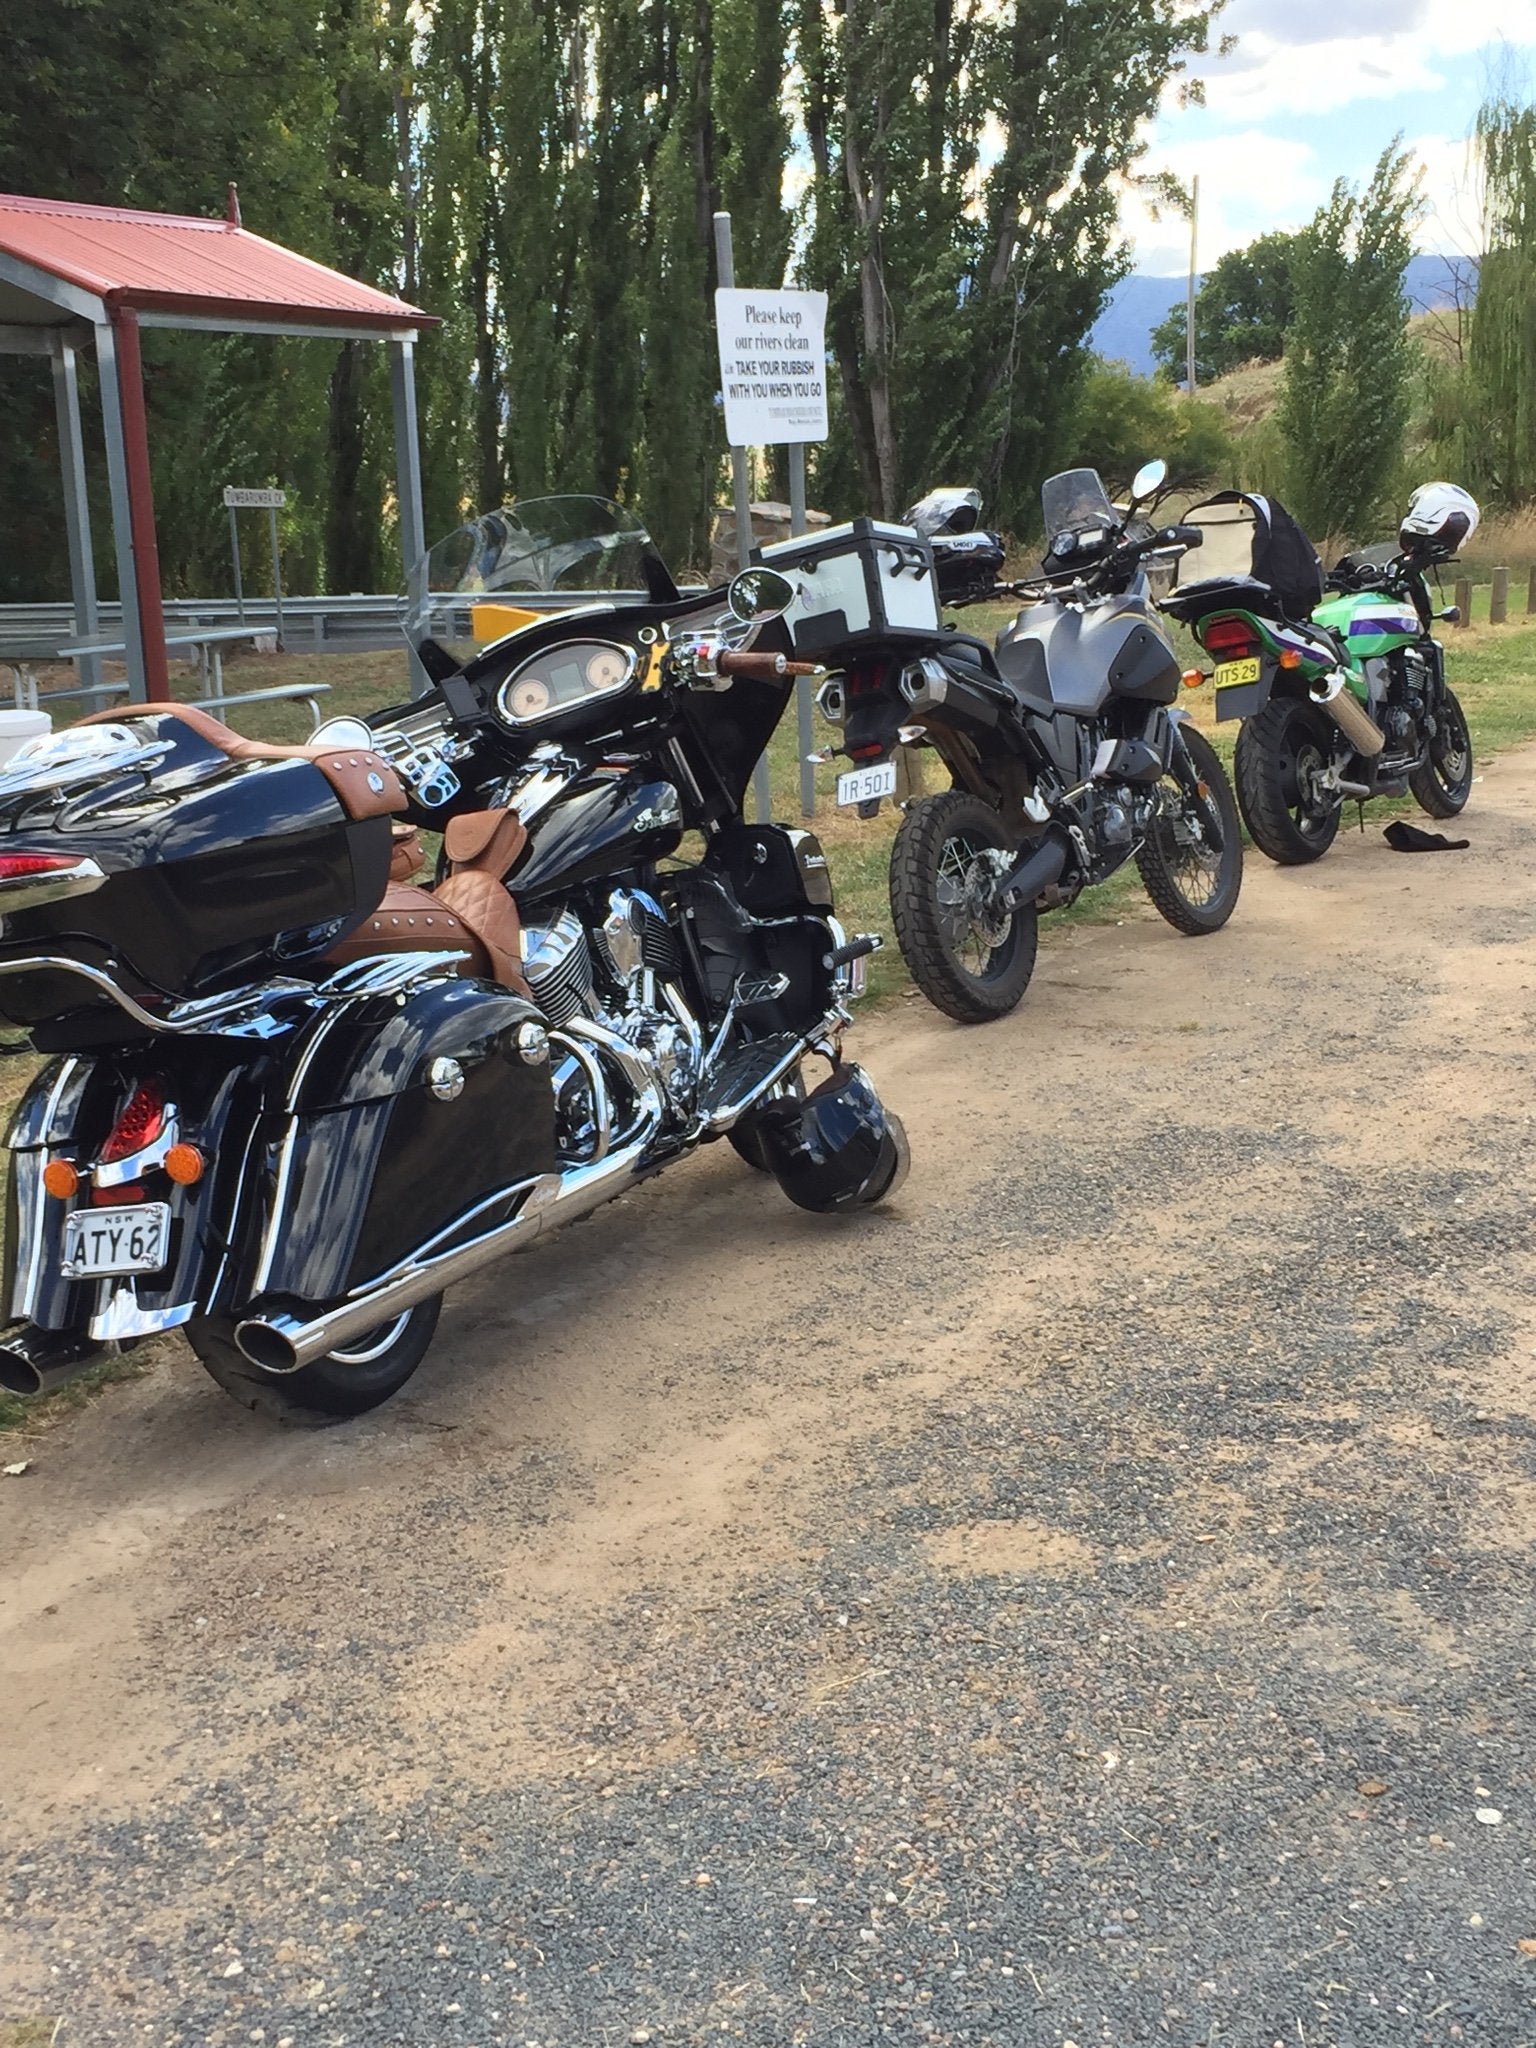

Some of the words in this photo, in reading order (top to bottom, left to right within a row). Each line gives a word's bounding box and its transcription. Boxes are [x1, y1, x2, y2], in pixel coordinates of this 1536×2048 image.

[745, 305, 777, 324] Please
[779, 306, 802, 328] keep
[735, 336, 752, 349] our
[754, 331, 782, 349] rivers
[784, 332, 809, 350] clean
[736, 360, 757, 375] TAKE
[758, 360, 780, 375] YOUR
[781, 360, 815, 376] RUBBISH
[729, 383, 750, 399] WITH
[751, 383, 767, 398] YOU
[769, 383, 792, 398] WHEN
[793, 382, 809, 398] YOU
[810, 382, 821, 397] GO
[105, 1215, 134, 1225] NSW
